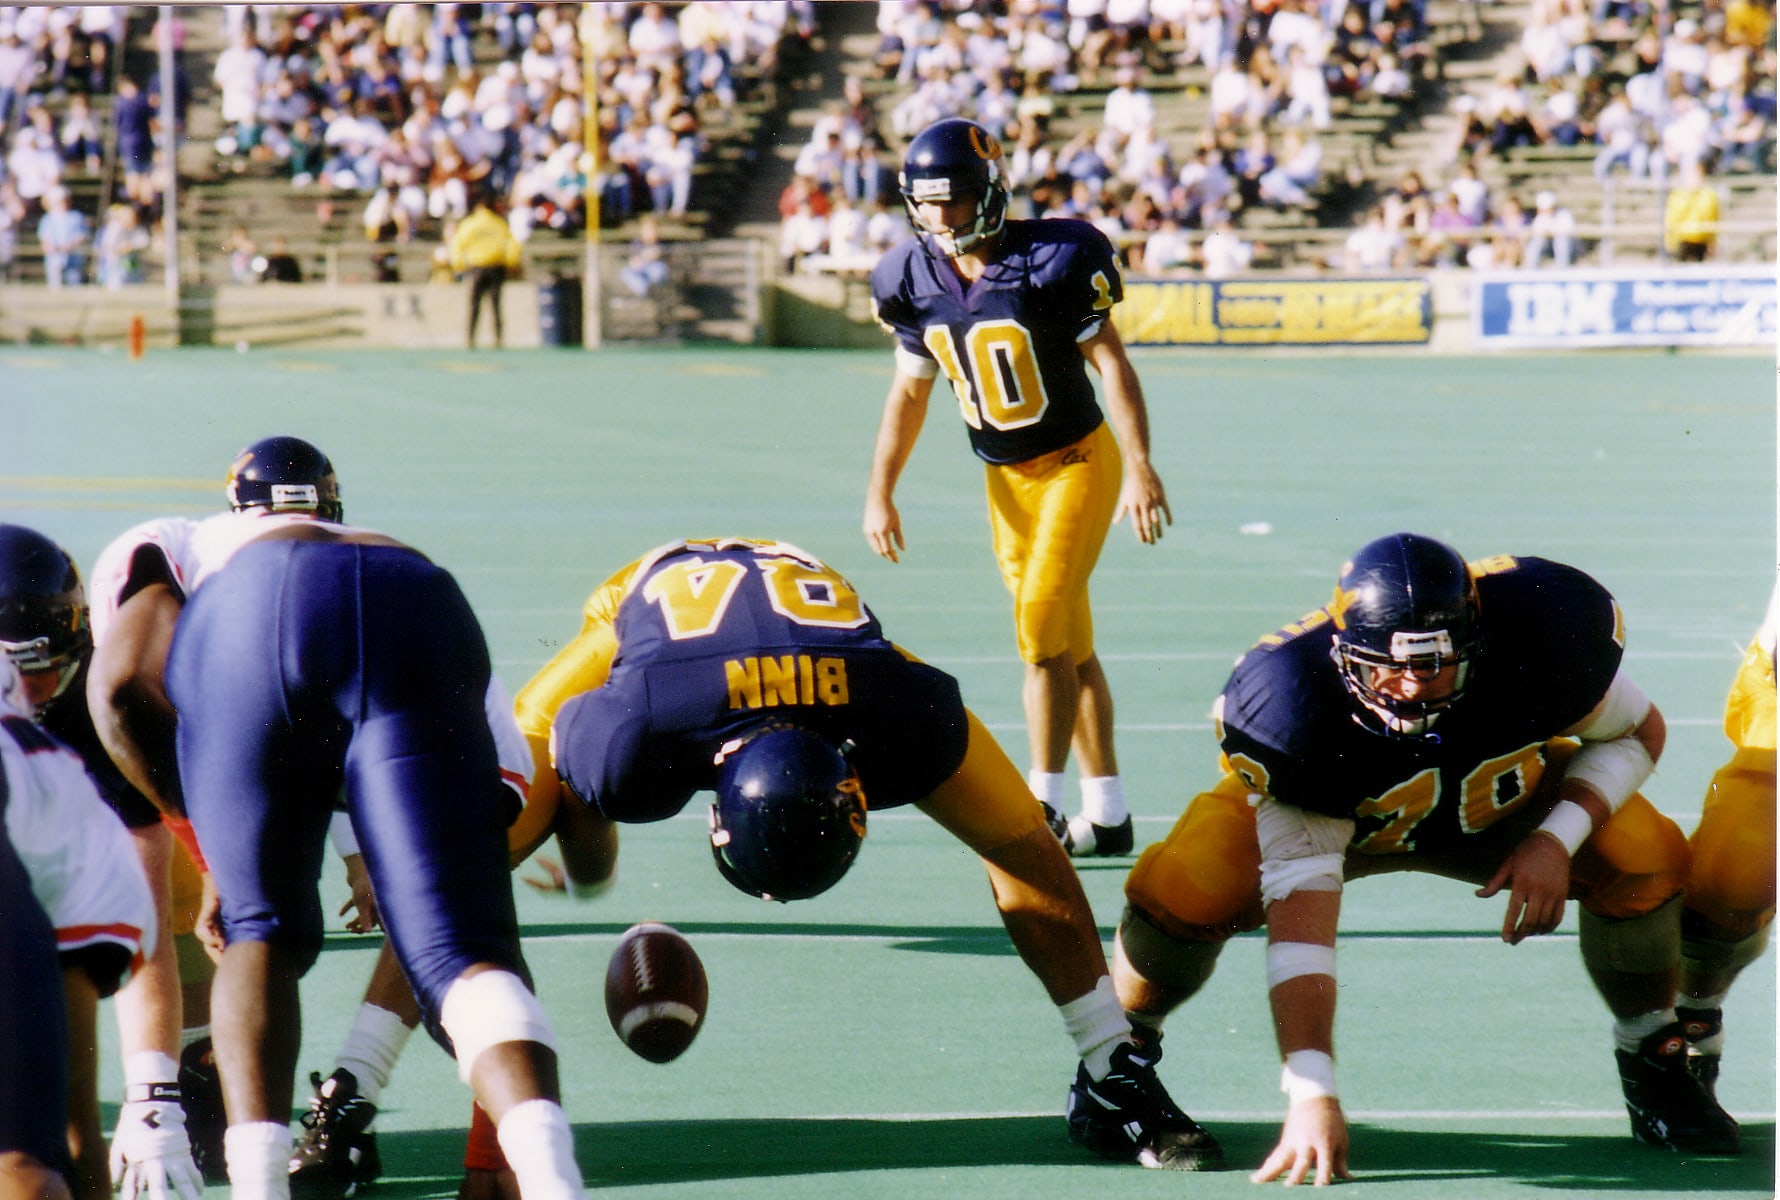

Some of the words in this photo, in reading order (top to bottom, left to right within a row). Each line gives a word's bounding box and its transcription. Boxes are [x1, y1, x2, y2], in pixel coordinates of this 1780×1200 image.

[1508, 283, 1616, 335] IBM
[923, 319, 1049, 431] 10
[643, 556, 870, 641] 84
[725, 655, 849, 709] BINN
[1351, 738, 1546, 855] 70
